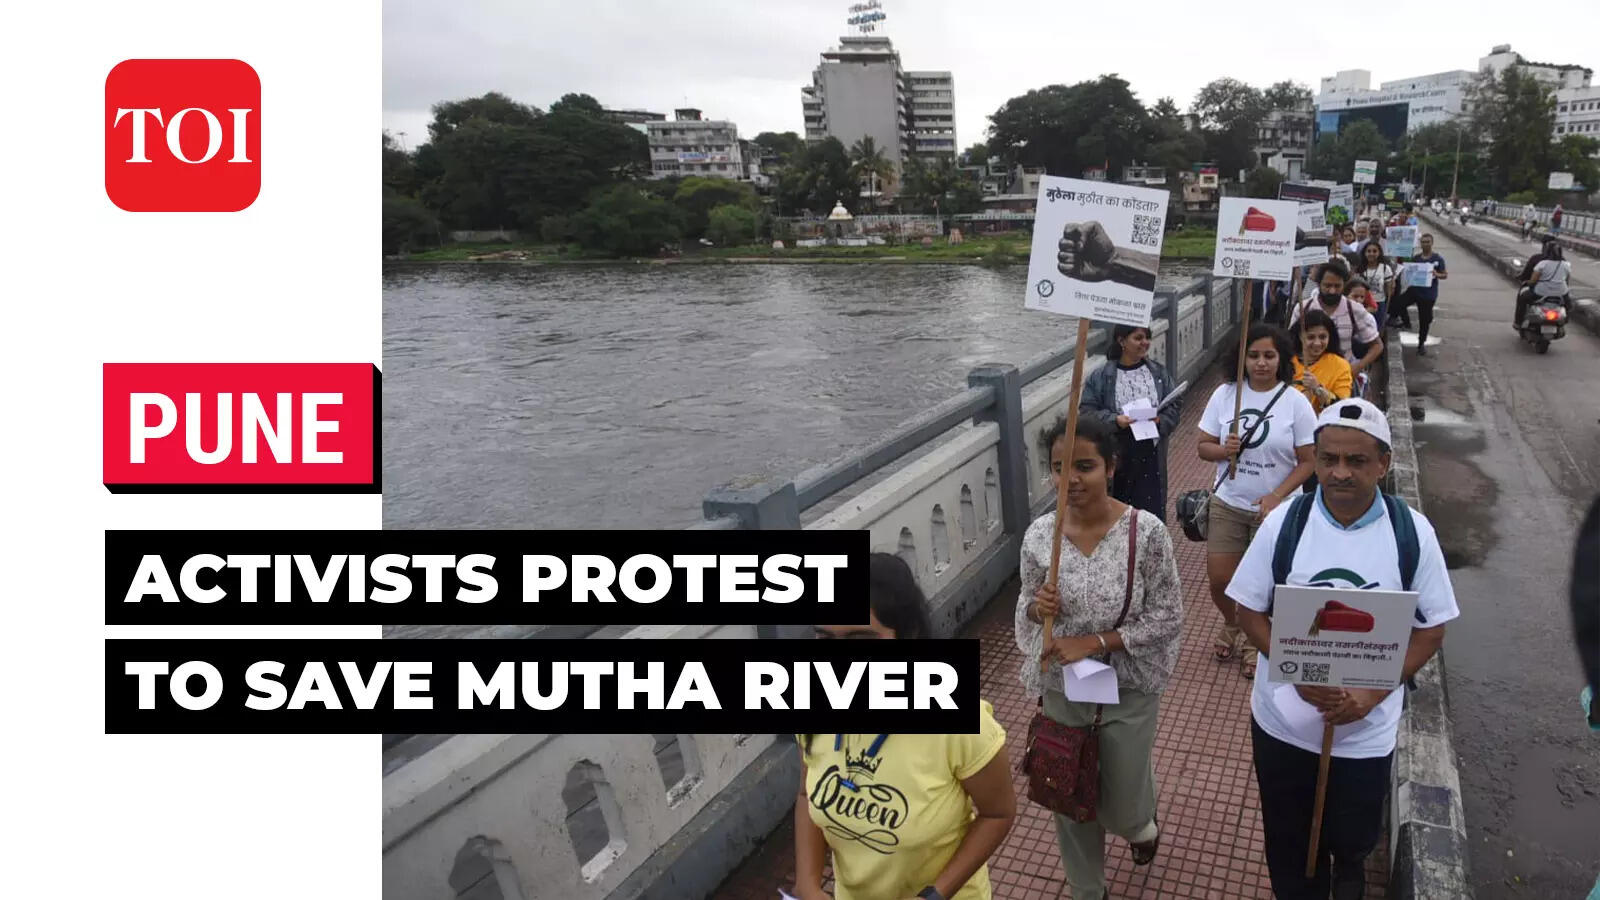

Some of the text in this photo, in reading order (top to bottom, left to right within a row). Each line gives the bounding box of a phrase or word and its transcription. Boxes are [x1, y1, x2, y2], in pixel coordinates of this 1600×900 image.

[1046, 186, 1075, 202] मुठेला
[1076, 191, 1103, 206] मुठीत
[1105, 196, 1120, 207] का
[810, 765, 908, 854] Queen
